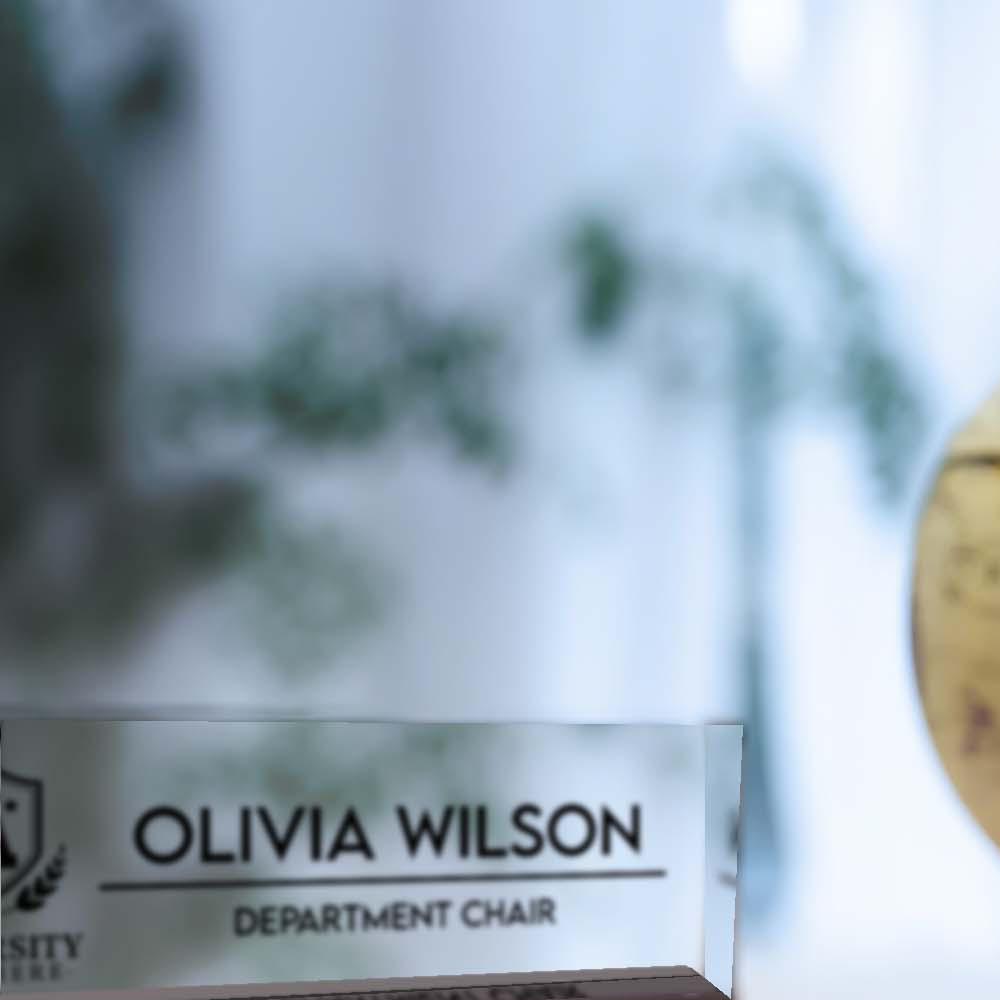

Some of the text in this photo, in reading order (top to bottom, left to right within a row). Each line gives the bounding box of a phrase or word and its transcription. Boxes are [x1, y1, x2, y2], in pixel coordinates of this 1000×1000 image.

[132, 803, 641, 866] OLIVIA WILSON
[234, 898, 556, 938] DEPARTMENT CHAIR
[0, 933, 82, 960] SITY
